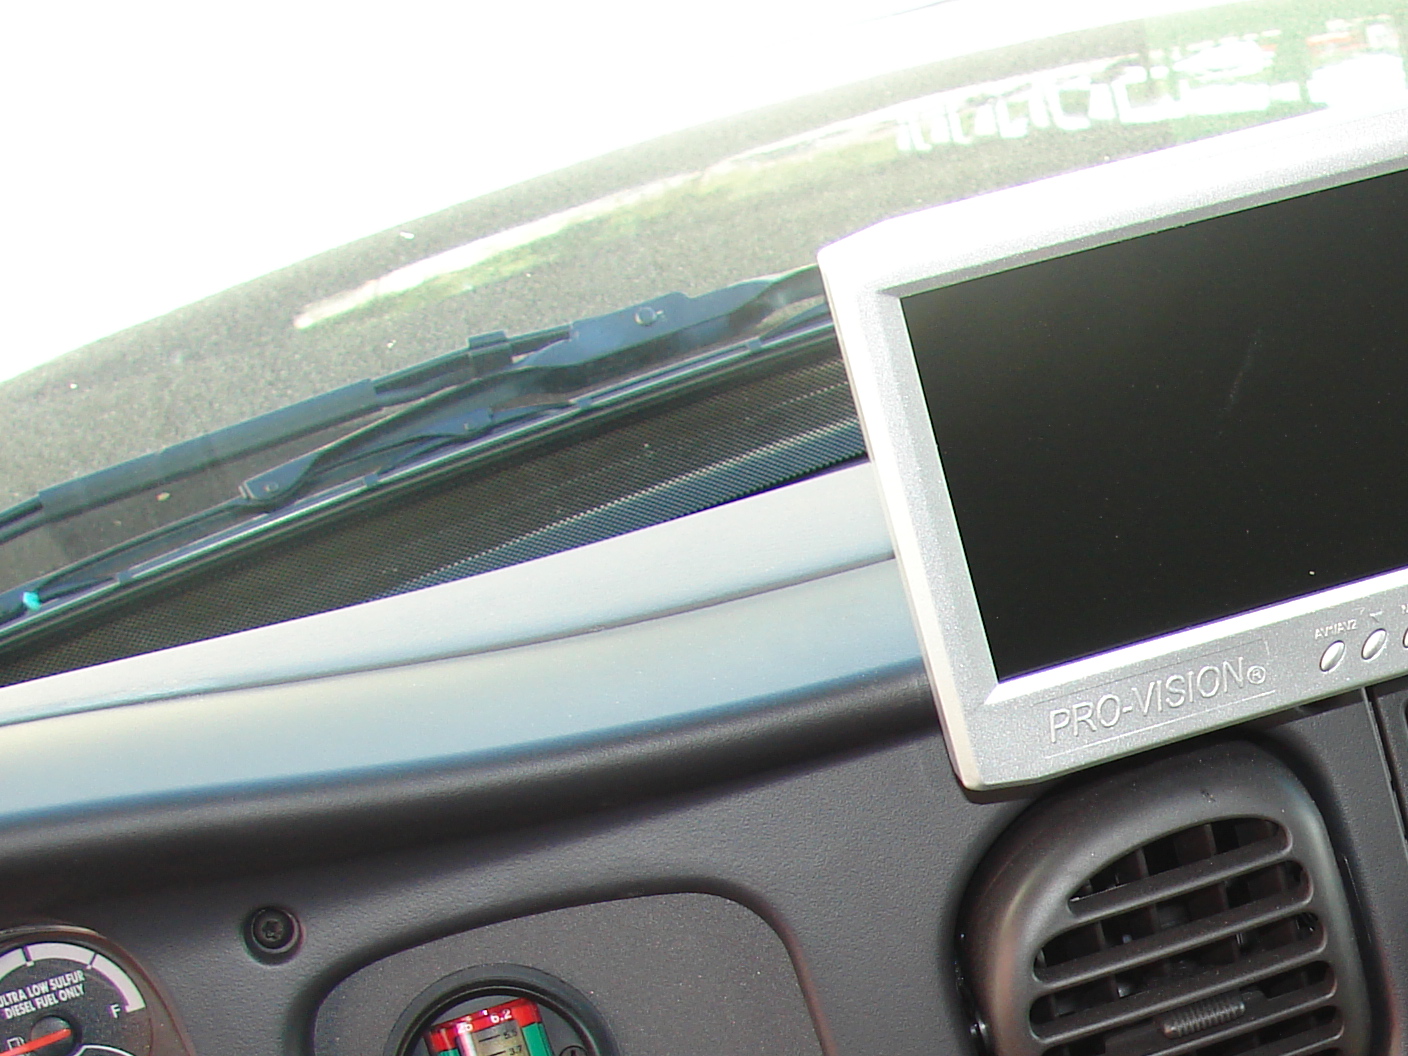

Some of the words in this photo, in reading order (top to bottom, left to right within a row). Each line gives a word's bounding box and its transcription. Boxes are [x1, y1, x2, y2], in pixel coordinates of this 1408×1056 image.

[27, 979, 49, 996] LOW
[49, 969, 86, 990] SULFUR
[3, 1002, 36, 1020] DIESEL
[35, 993, 59, 1009] FUEL
[58, 983, 85, 1001] ONLY
[110, 1004, 121, 1019] F
[490, 1008, 513, 1024] 6.2
